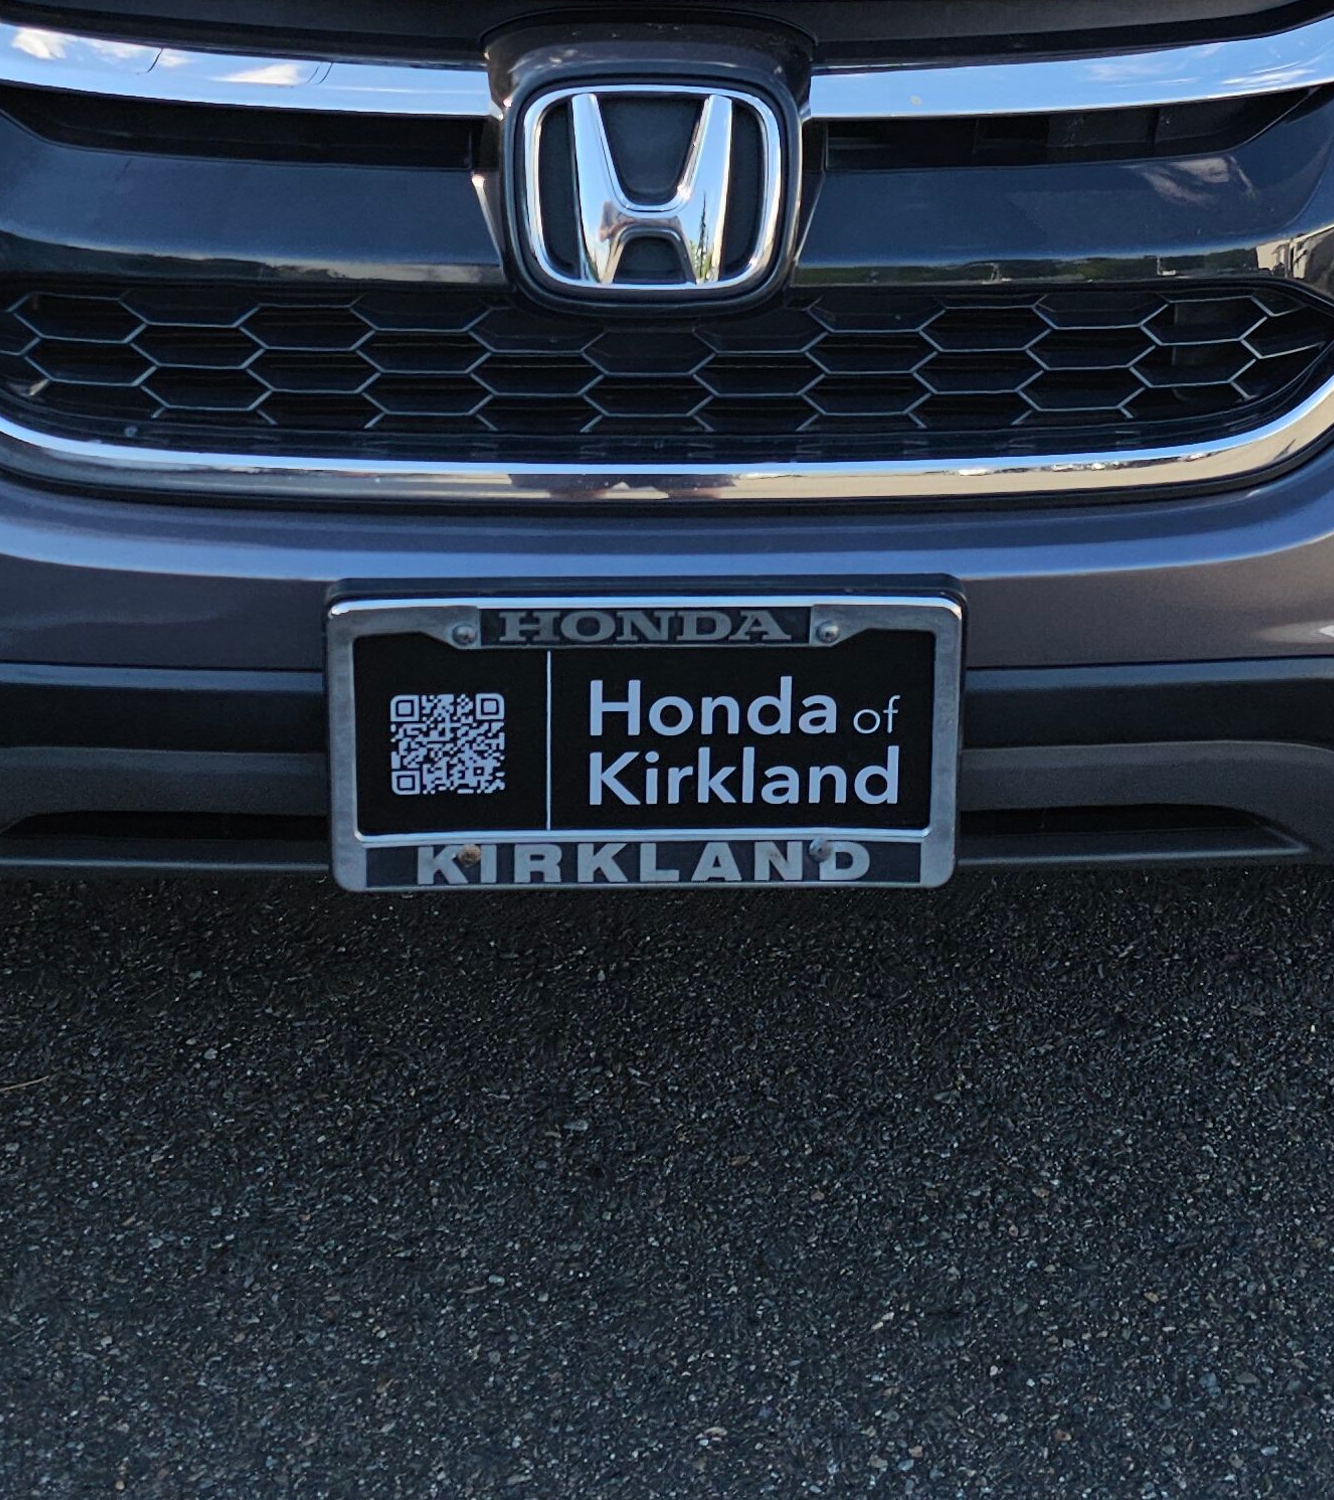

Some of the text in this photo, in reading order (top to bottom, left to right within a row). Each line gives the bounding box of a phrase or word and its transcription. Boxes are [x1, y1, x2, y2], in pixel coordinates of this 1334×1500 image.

[498, 610, 791, 643] HONDA
[589, 676, 901, 737] Honda of
[589, 746, 900, 806] Kirkland
[417, 843, 871, 884] KIRKLAND
